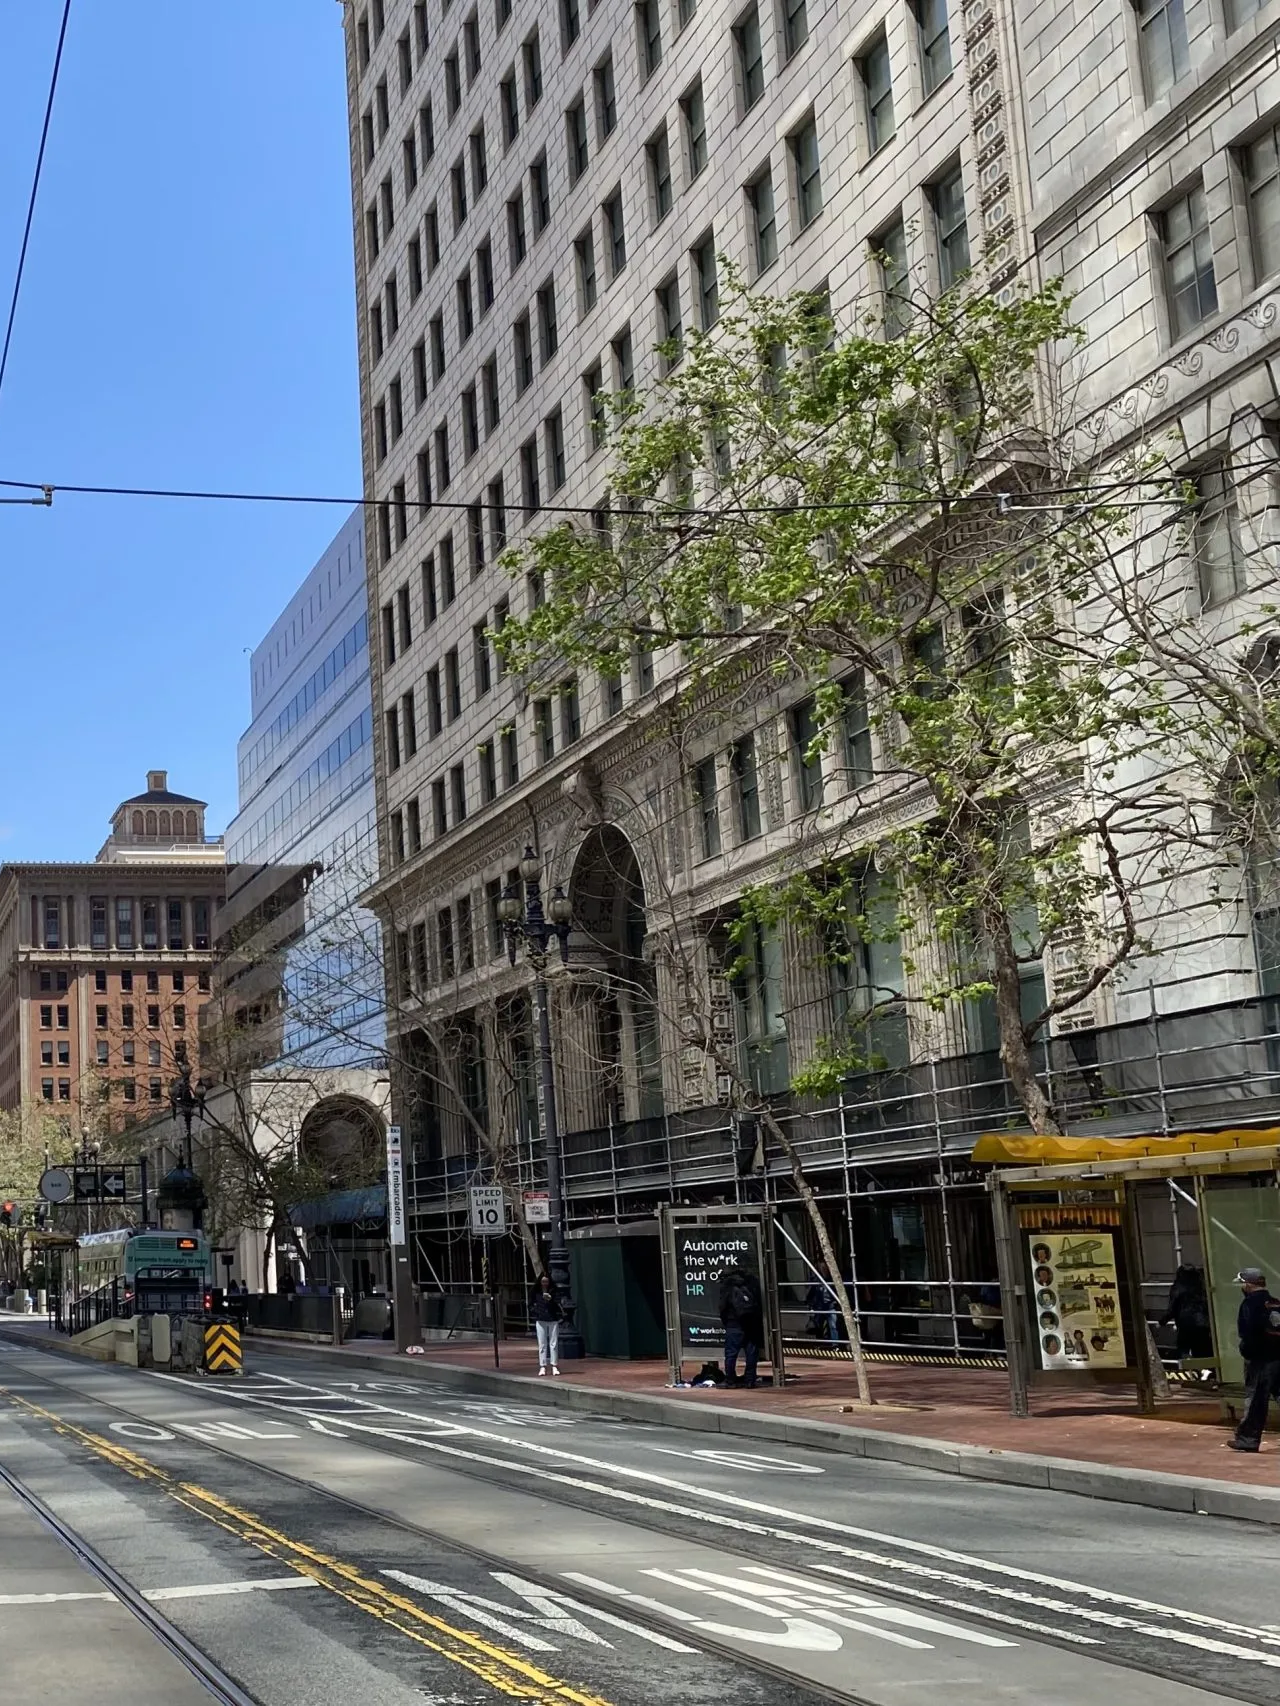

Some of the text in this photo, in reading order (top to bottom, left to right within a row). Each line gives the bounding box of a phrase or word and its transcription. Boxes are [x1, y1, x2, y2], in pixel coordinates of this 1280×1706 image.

[393, 1170, 402, 1226] Embarcadero
[472, 1189, 501, 1197] SPEED
[476, 1199, 499, 1207] LIMIT
[478, 1209, 499, 1225] 10
[683, 1239, 749, 1252] Automate
[684, 1255, 705, 1266] the
[685, 1270, 707, 1281] out
[686, 1285, 705, 1296] HR
[108, 1420, 350, 1441] ONLY
[651, 1448, 825, 1474] 10
[378, 1564, 1107, 1654] MUNI
